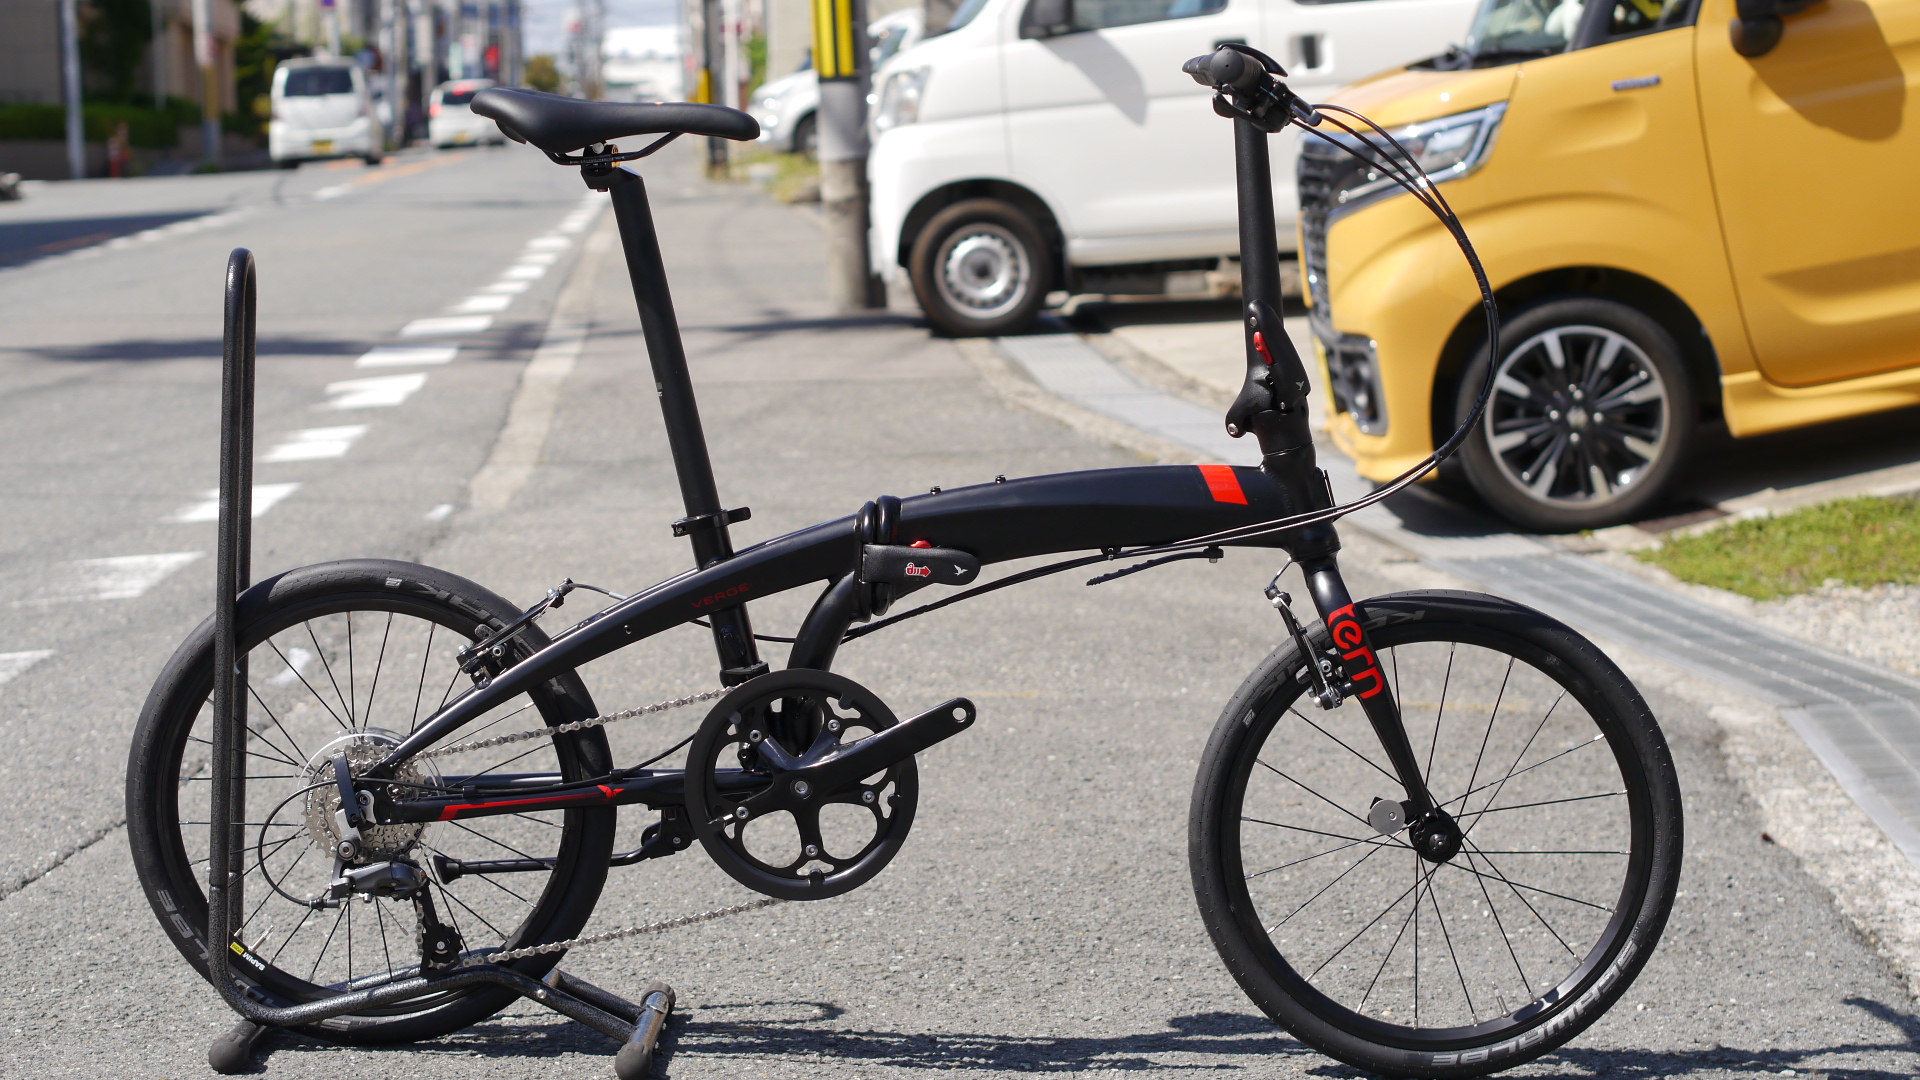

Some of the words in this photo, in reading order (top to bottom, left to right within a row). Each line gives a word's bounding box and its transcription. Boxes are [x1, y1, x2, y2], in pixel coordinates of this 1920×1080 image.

[1327, 603, 1384, 699] tern
[242, 951, 266, 971] SAPIM
[1431, 940, 1638, 1066] SCHWALBE
